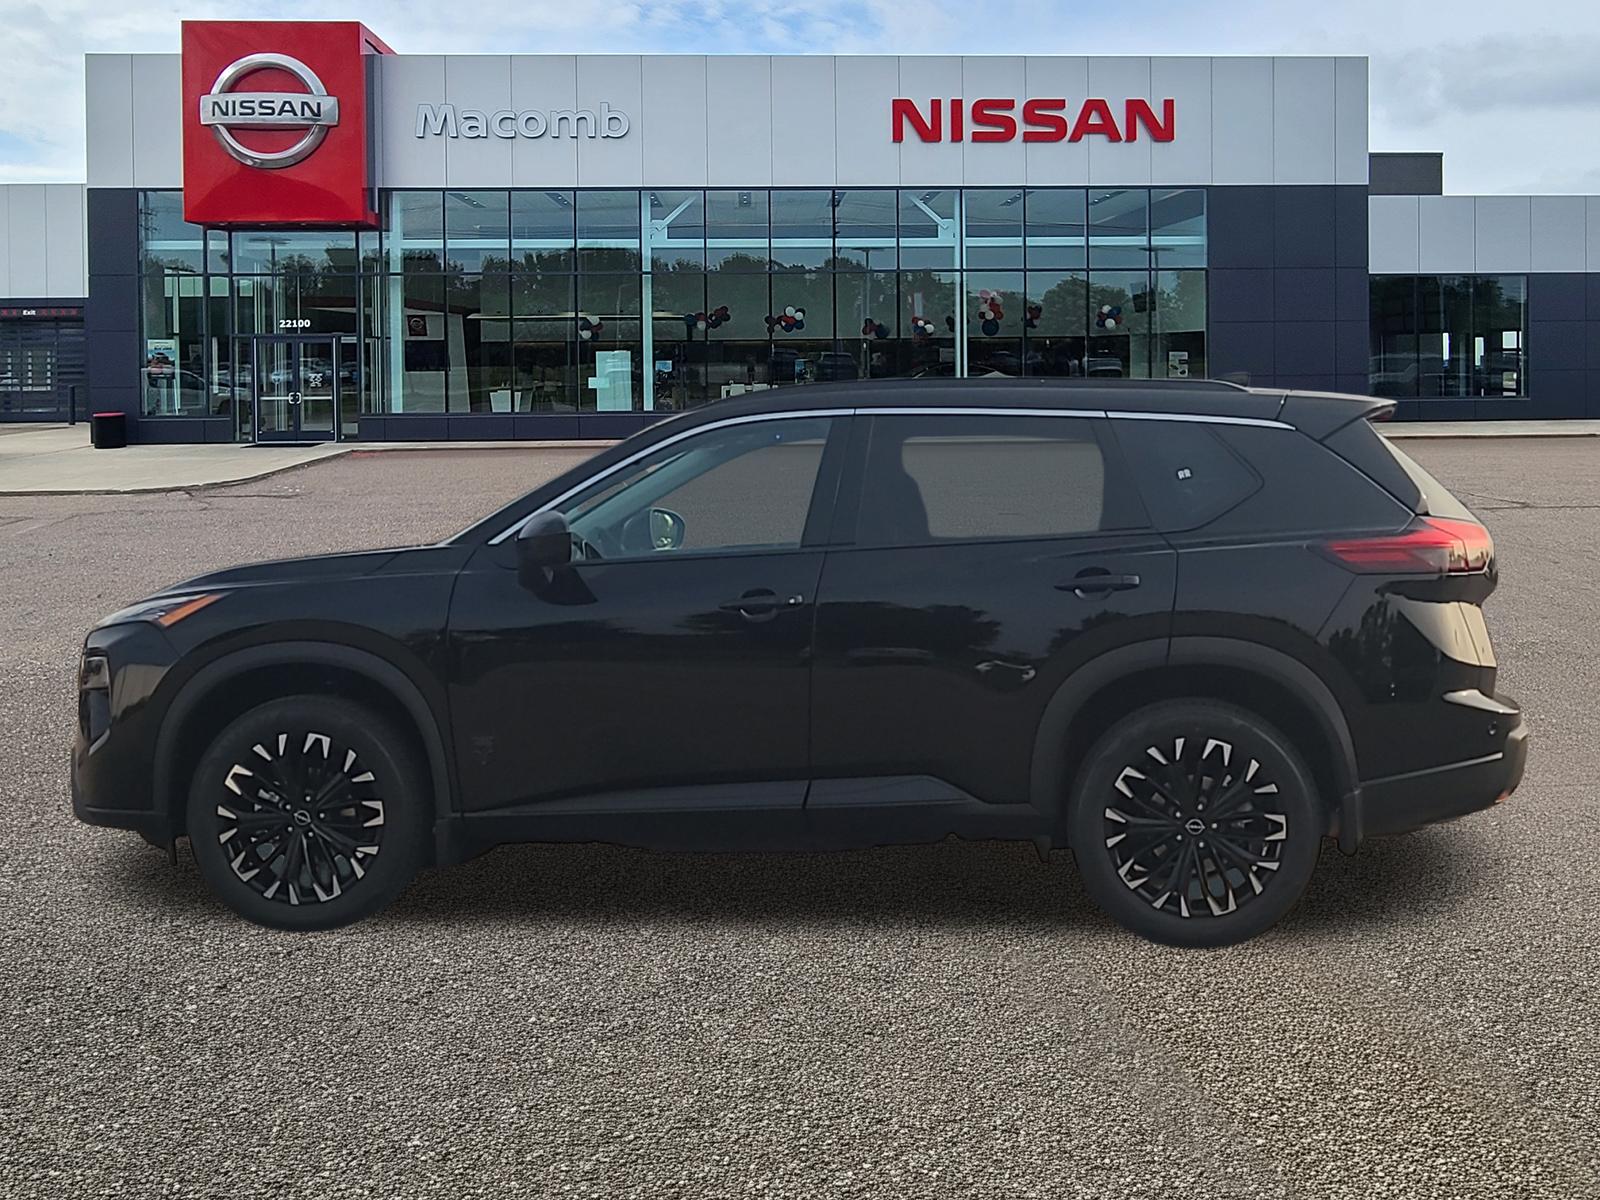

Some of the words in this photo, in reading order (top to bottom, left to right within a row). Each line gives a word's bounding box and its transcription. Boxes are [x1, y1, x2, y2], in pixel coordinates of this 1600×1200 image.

[212, 100, 322, 118] NISSAN
[415, 101, 630, 139] Macomb
[891, 98, 1175, 144] NISSAN
[279, 319, 311, 328] 22100
